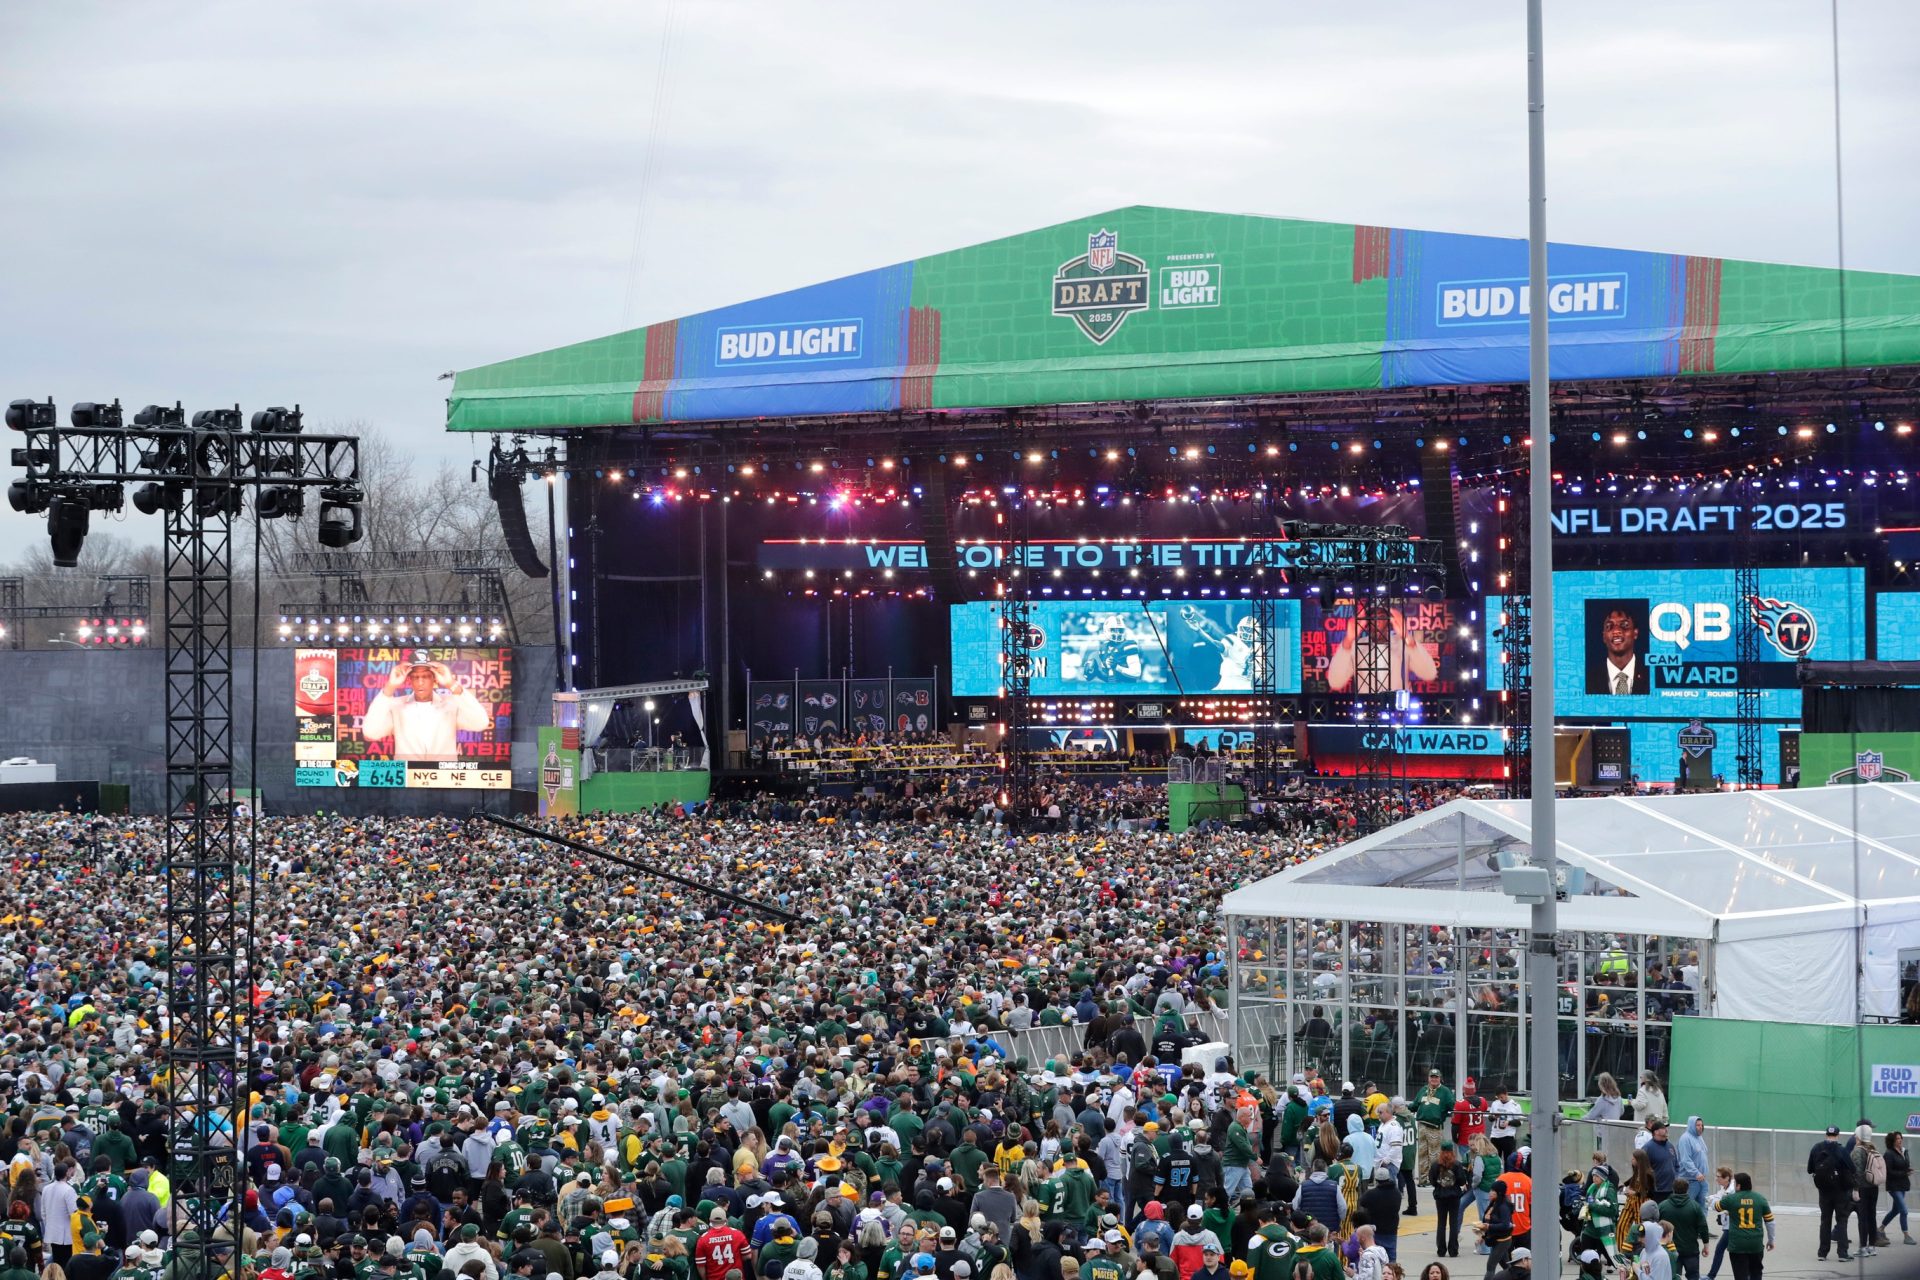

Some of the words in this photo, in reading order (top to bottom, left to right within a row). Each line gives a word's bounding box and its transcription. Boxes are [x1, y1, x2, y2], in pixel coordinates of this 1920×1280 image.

[1091, 249, 1112, 267] NFL
[1167, 253, 1204, 261] PRESENTED
[1206, 252, 1215, 260] BY
[1171, 269, 1210, 288] BUD
[1060, 281, 1141, 305] DRAFT
[1163, 286, 1217, 305] LIGHT
[1443, 287, 1515, 319] BUD
[1520, 281, 1621, 314] LGHT
[1089, 313, 1112, 323] 2025
[720, 331, 776, 360] BUD
[779, 325, 857, 356] LIGHT
[1551, 508, 1611, 533] NFL
[1621, 505, 1742, 532] DRAFT
[1752, 503, 1846, 529] 2025
[1054, 546, 1104, 567] TO
[1112, 545, 1182, 567] THE
[1649, 602, 1731, 651] QB
[472, 661, 511, 675] NFL
[1648, 655, 1679, 665] CAM
[1662, 666, 1738, 684] WARD
[302, 682, 327, 690] DRAFT
[1418, 734, 1488, 751] WARD
[371, 770, 404, 786] 6:45
[413, 772, 438, 780] NYG
[481, 773, 503, 781] CLE
[1861, 764, 1879, 776] NFL
[1558, 997, 1573, 1013] 15
[1881, 1067, 1912, 1081] BUD
[1874, 1080, 1918, 1094] LIGHT
[1468, 1111, 1483, 1126] 13
[601, 1125, 610, 1141] 4
[511, 1151, 524, 1171] 10
[1170, 1167, 1191, 1187] 97
[1738, 1207, 1756, 1229] 11
[712, 1244, 735, 1265] 44
[1268, 1241, 1291, 1257] G
[406, 1253, 426, 1264] WHITE
